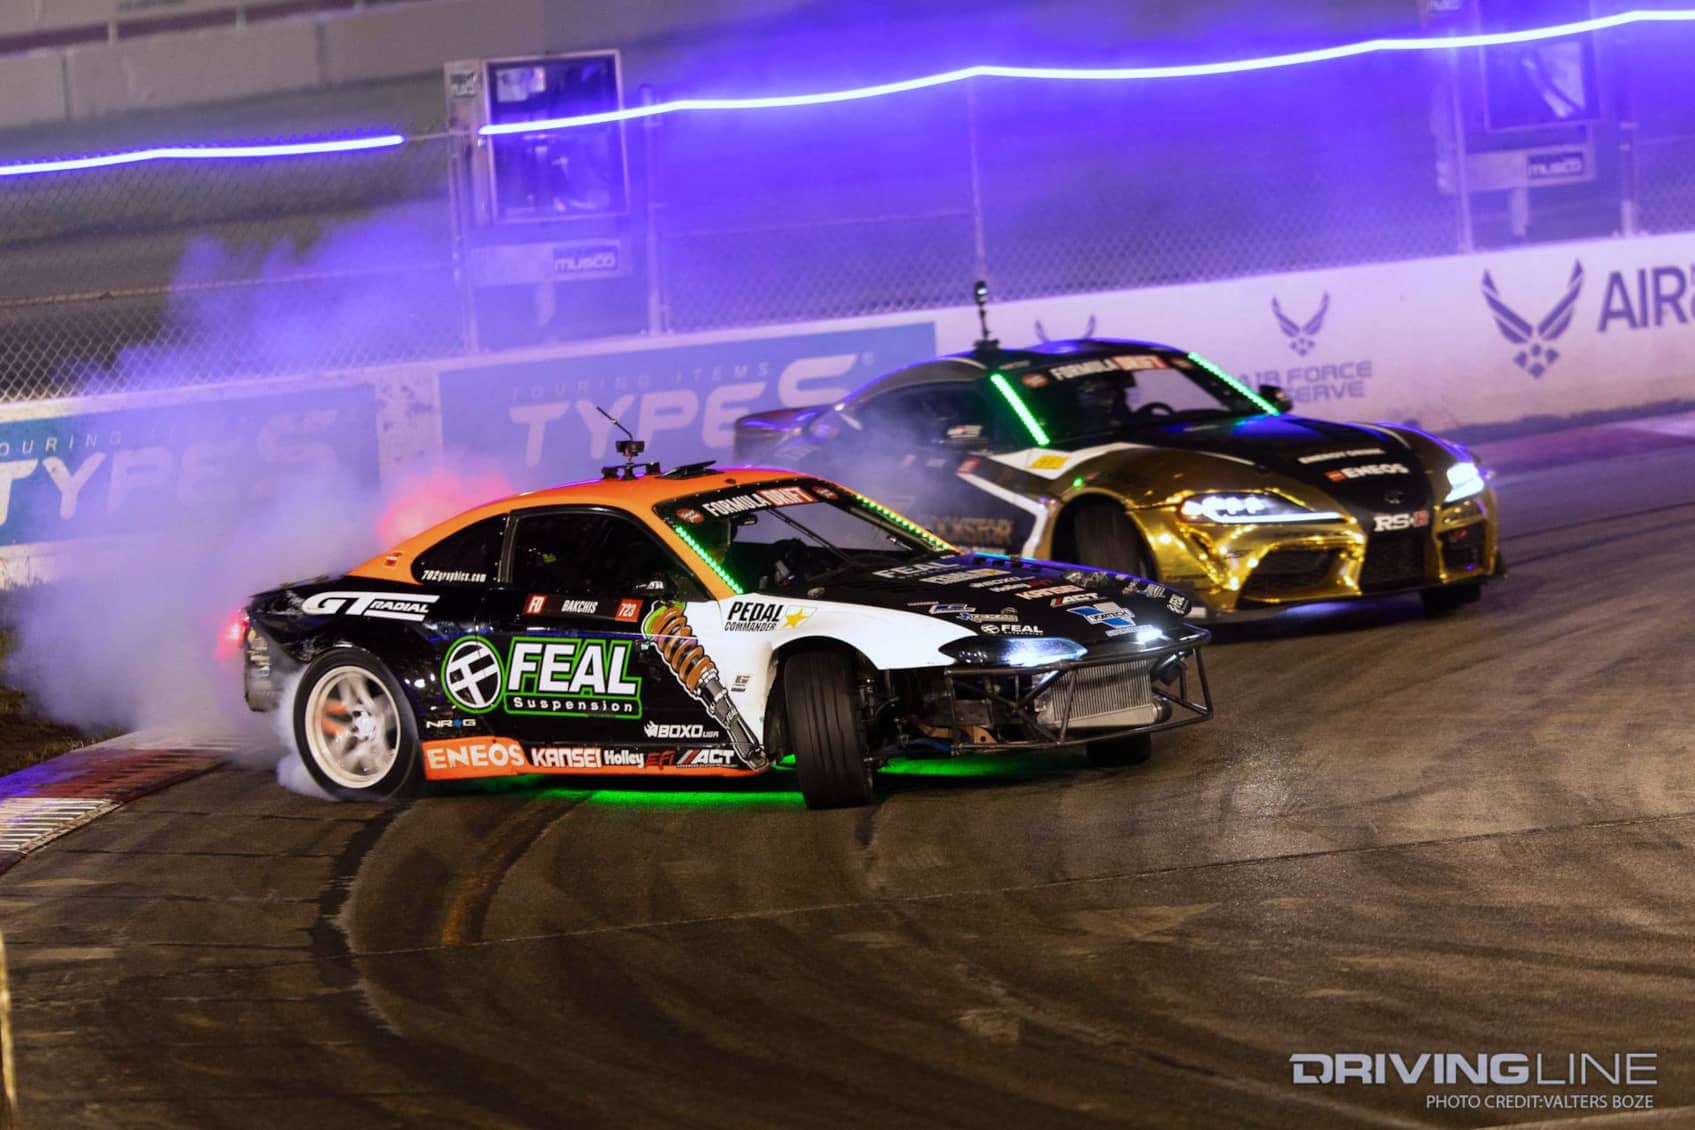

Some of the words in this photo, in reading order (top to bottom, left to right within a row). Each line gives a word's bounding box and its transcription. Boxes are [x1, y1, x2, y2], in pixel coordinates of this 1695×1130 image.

[1597, 265, 1688, 333] AIR
[1286, 360, 1373, 385] FORCE
[509, 382, 768, 468] TYPE
[0, 431, 122, 457] OURING
[702, 494, 772, 517] FORMULA
[872, 561, 961, 579] FEAL
[301, 591, 441, 620] GT
[370, 600, 429, 614] RADIAL
[561, 600, 598, 614] BAKCHIS
[618, 603, 637, 617] 723
[727, 601, 784, 622] PEDAL
[724, 621, 777, 632] COMMANDER
[1001, 624, 1043, 633] FEAL
[508, 642, 637, 695] FEAL
[513, 697, 633, 712] Suspension
[656, 724, 704, 738] BOXO
[427, 743, 525, 770] ENEOS
[531, 748, 602, 768] KANSEI
[603, 750, 645, 769] Holley
